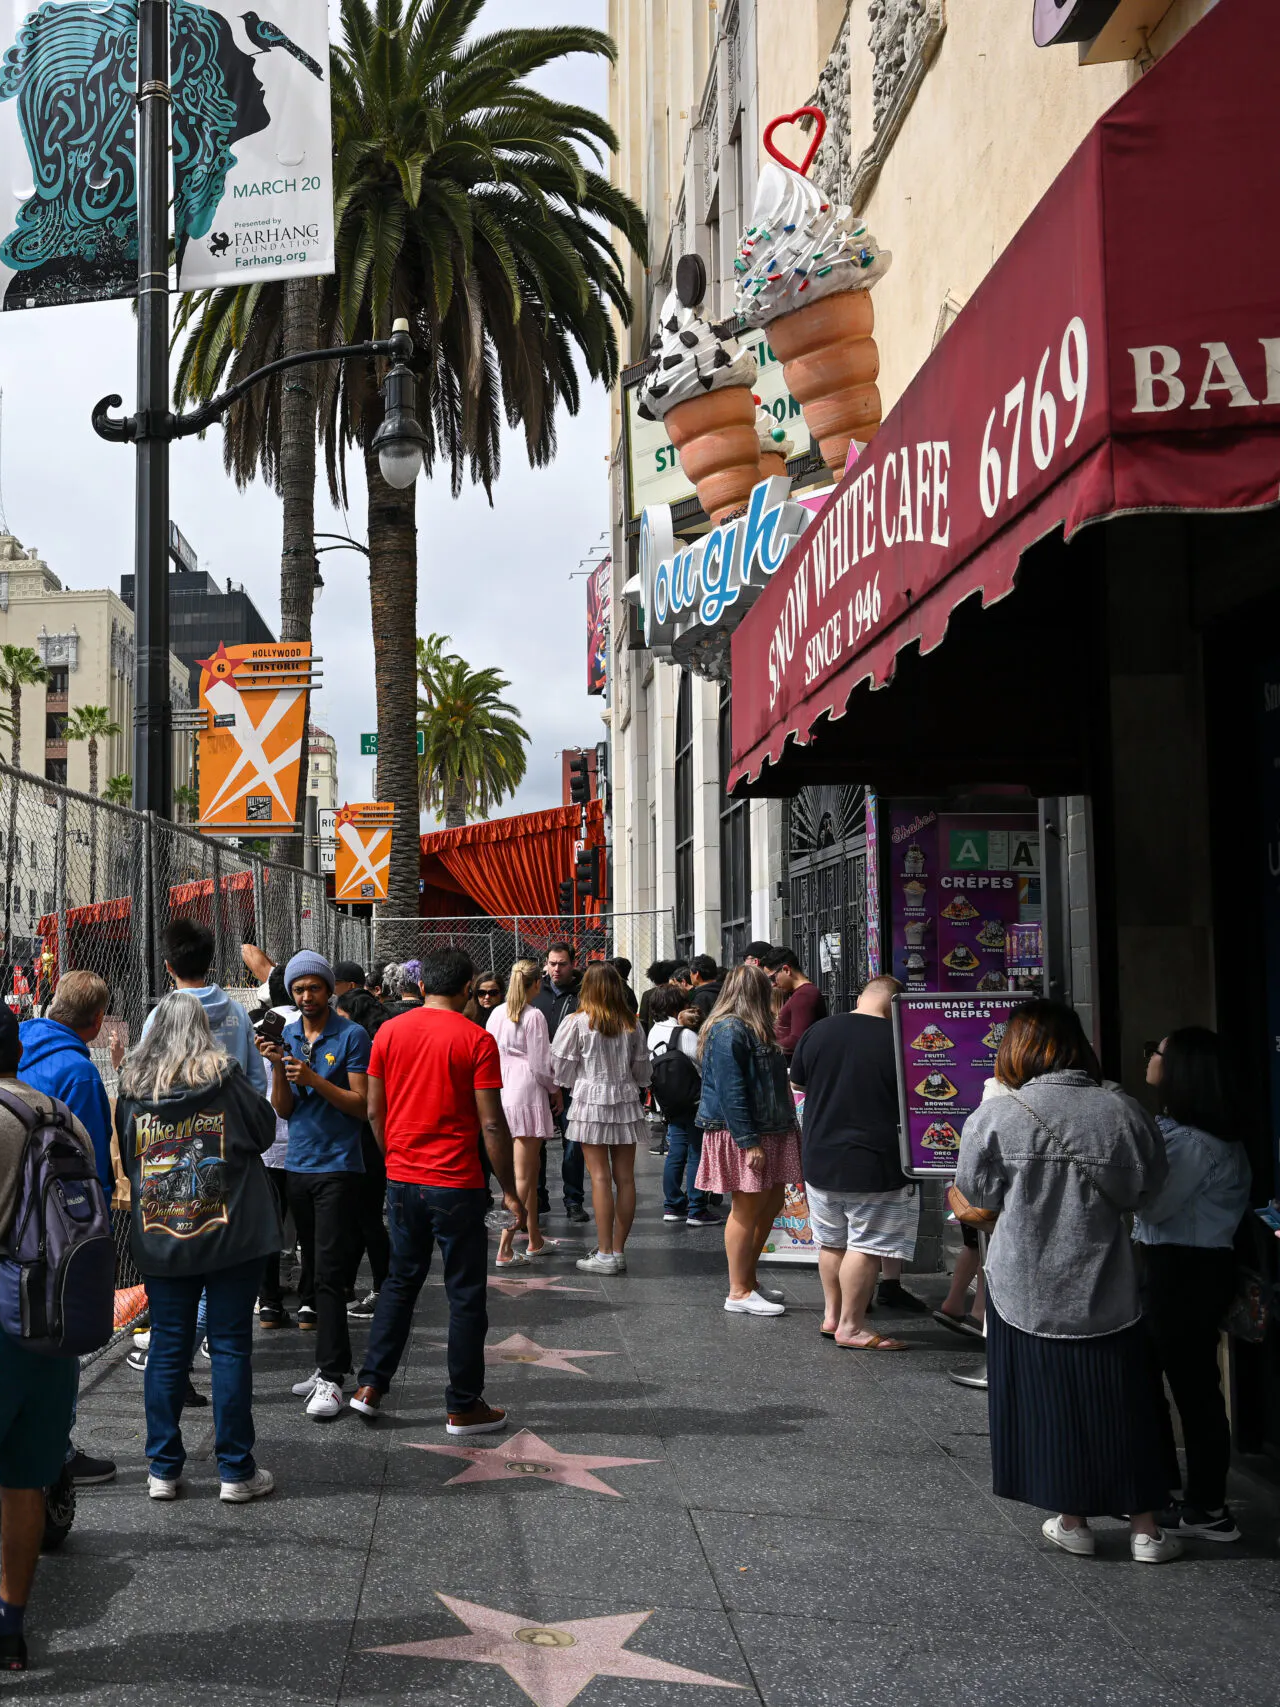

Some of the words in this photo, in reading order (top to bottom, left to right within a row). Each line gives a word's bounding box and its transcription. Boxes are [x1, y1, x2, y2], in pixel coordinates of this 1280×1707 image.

[233, 178, 297, 199] MARCH
[301, 176, 321, 191] 20
[234, 218, 271, 229] Presented
[272, 217, 282, 226] by
[234, 223, 319, 247] FARHANG
[234, 238, 320, 255] FOUNDATION
[234, 251, 307, 268] Farhang.org
[979, 315, 1089, 519] 6769
[768, 549, 810, 713] SNOW
[812, 463, 877, 607] WHITE
[880, 441, 951, 548] CAFE
[805, 608, 842, 686] SINCE
[847, 569, 882, 648] 1946
[252, 648, 301, 658] HOLLYWOOD
[216, 663, 226, 673] 6
[252, 662, 301, 672] HISTORIC
[891, 810, 937, 844] Shakes
[955, 839, 981, 862] A
[1012, 840, 1034, 866] A
[940, 873, 1014, 889] CRÊPES
[908, 1001, 975, 1010] HOMEMADE
[979, 1000, 1026, 1009] FRENC
[943, 1008, 991, 1019] CRÊPES
[135, 1112, 175, 1158] Bike
[175, 1112, 223, 1140] Week
[145, 1200, 185, 1225] Daytona
[175, 1222, 193, 1231] 2022
